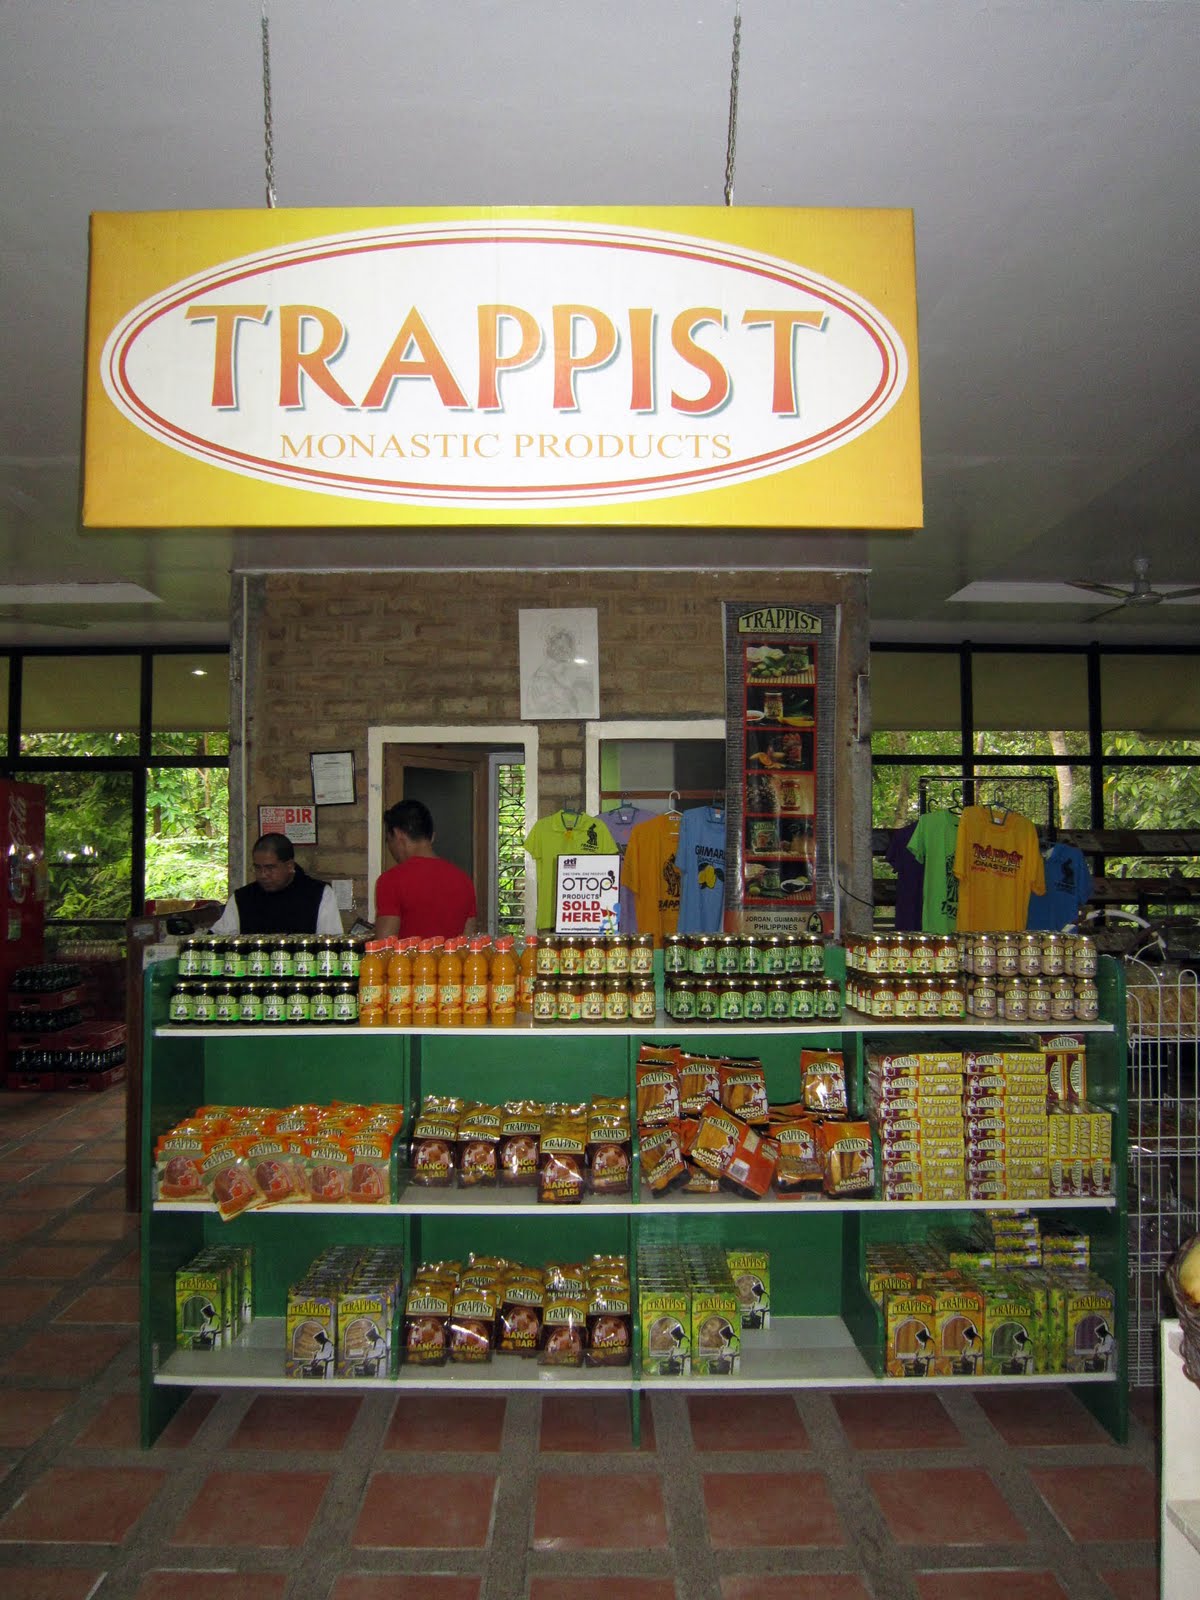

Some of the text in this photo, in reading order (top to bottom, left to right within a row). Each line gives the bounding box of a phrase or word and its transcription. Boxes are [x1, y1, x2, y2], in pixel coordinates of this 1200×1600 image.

[186, 304, 830, 418] TRAPPIST
[280, 433, 733, 460] MONASTIC PRODUCTS
[742, 608, 819, 629] TRAPPIST
[286, 809, 312, 823] BIR
[562, 901, 600, 911] SOLD
[562, 912, 601, 922] HERE
[1050, 1037, 1078, 1048] TRAPPIST
[893, 1057, 918, 1066] TRAPPIST
[977, 1055, 1002, 1064] TRAPPIST
[683, 1065, 715, 1074] TRAPPIST
[808, 1064, 839, 1073] TRAPPIST
[642, 1073, 673, 1085] TRAPPIST
[727, 1074, 760, 1084] TRAPPIST
[892, 1077, 918, 1087] TRAPPIST
[980, 1076, 1005, 1086] TRAPPIST
[1050, 1063, 1061, 1092] TRAPPIST
[1070, 1062, 1082, 1091] TRAPPIST
[891, 1099, 917, 1108] TRAPPIST
[978, 1097, 1002, 1106] TRAPPIST
[645, 1107, 671, 1116] MANGO
[735, 1106, 760, 1115] MANGO
[644, 1112, 676, 1122] BISCOCHO
[505, 1123, 540, 1131] TRAPPIST
[709, 1116, 739, 1138] TRAPPIST
[894, 1120, 919, 1129] TRAPPIST
[979, 1118, 1004, 1128] TRAPPIST
[419, 1126, 454, 1138] TRAPPIST
[592, 1129, 628, 1139] TRAPPIST
[778, 1130, 809, 1140] TRAPPIST
[166, 1139, 200, 1150] TRAPPIST
[544, 1139, 582, 1150] TRAPPIST
[642, 1130, 672, 1150] TRAPPIST
[836, 1140, 868, 1149] TRAPPIST
[894, 1140, 919, 1150] TRAPPIST
[979, 1139, 1004, 1149] TRAPPIST
[249, 1143, 282, 1157] TRAPPIST
[312, 1149, 347, 1162] TRAPPIST
[698, 1147, 722, 1162] MANGO
[204, 1150, 234, 1169] TRAPPIST
[979, 1160, 1004, 1170] TRAPPIST
[417, 1163, 448, 1171] MANGO
[895, 1161, 921, 1171] TRAPPIST
[544, 1181, 578, 1190] MANGO
[835, 1182, 872, 1192] BISCOCHO
[839, 1177, 867, 1188] MANGO
[557, 1187, 579, 1196] BARS
[731, 1256, 766, 1268] TRAPPIST
[180, 1277, 217, 1290] TRAPPIST
[874, 1278, 912, 1289] TRAPPIST
[507, 1288, 543, 1302] TRAPPIST
[292, 1300, 330, 1314] TRAPPIST
[343, 1298, 381, 1312] TRAPPIST
[411, 1299, 446, 1310] TRAPPIST
[590, 1301, 628, 1311] TRAPPIST
[648, 1298, 685, 1309] TRAPPIST
[699, 1298, 735, 1309] TRAPPIST
[895, 1300, 932, 1313] TRAPPIST
[941, 1297, 978, 1310] TRAPPIST
[1074, 1296, 1111, 1308] TRAPPIST
[456, 1302, 493, 1314] TRAPPIST
[992, 1304, 1030, 1316] TRAPPIST
[548, 1308, 583, 1320] TRAPPIST
[503, 1332, 536, 1340] MANGO
[515, 1339, 536, 1348] BARS
